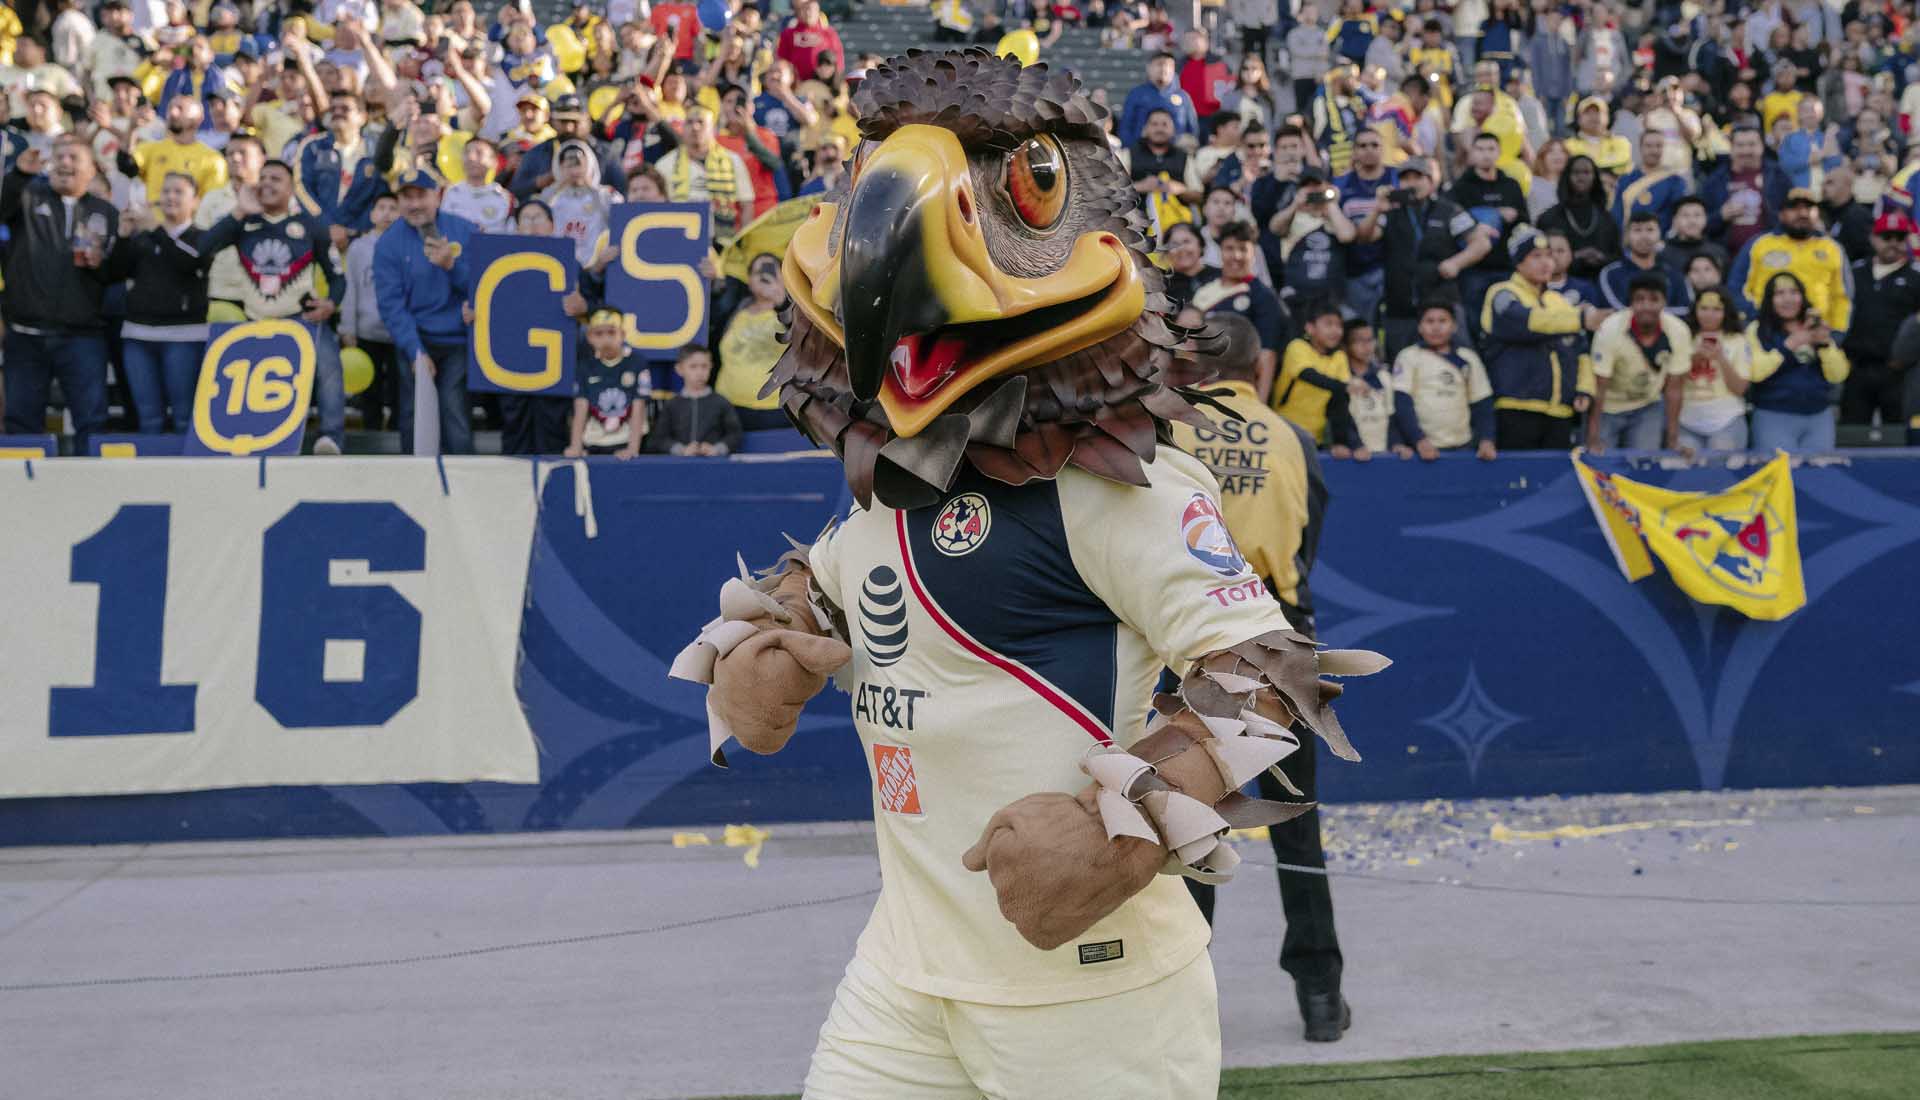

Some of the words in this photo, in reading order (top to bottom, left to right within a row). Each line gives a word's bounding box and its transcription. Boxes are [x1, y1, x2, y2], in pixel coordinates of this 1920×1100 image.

[620, 212, 705, 349] S
[473, 252, 566, 391] G
[222, 356, 294, 415] 16
[1194, 419, 1269, 445] CSC
[1194, 447, 1268, 469] EVENT
[48, 501, 426, 738] 16
[856, 681, 925, 731] AT&T
